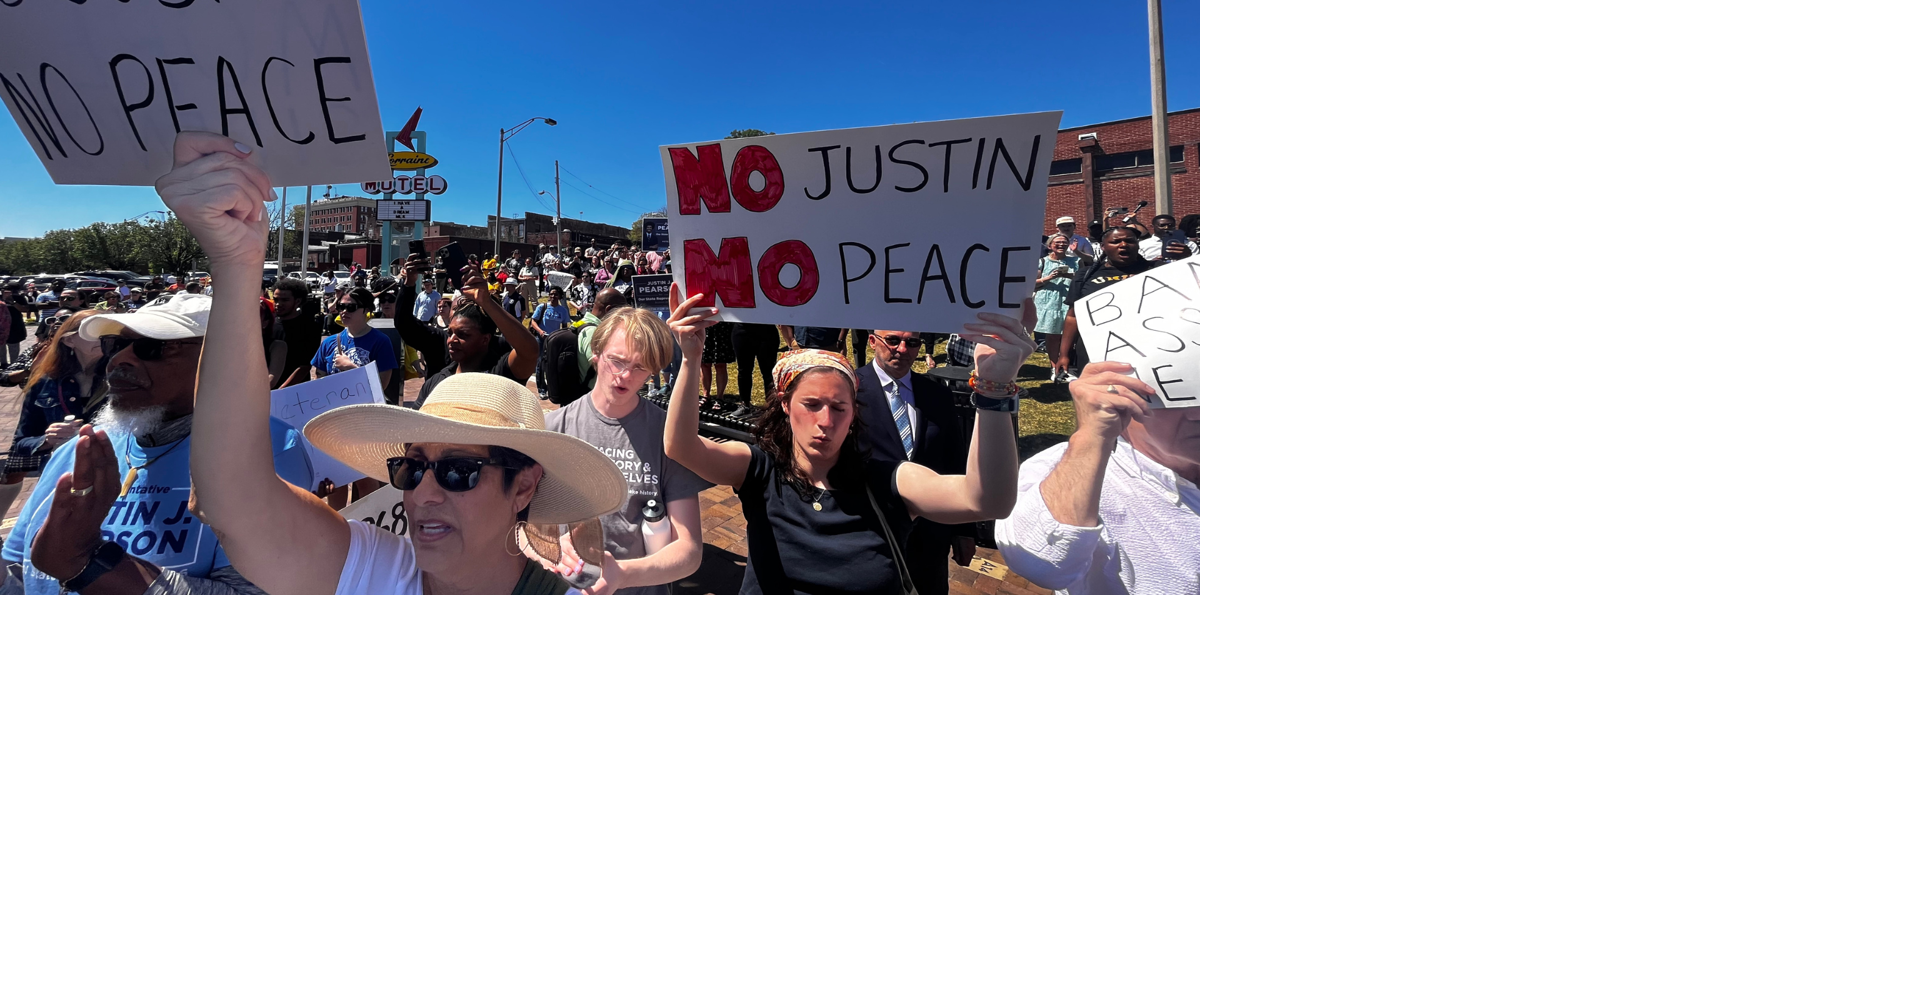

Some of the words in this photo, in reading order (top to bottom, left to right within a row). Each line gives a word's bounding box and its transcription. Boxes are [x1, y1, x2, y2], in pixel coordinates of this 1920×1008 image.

[0, 62, 104, 160] NO
[108, 53, 367, 152] PEACE
[669, 143, 785, 215] NO
[804, 134, 1041, 200] JUSTIN
[684, 236, 820, 308] NO
[838, 241, 1031, 309] PEACE
[638, 285, 670, 293] PEARS
[278, 382, 367, 420] eteran
[595, 446, 635, 460] ACING
[612, 460, 642, 471] ORY
[642, 462, 651, 472] &
[622, 472, 659, 484] ELVES
[128, 484, 171, 495] ntative
[107, 500, 161, 526] TIN
